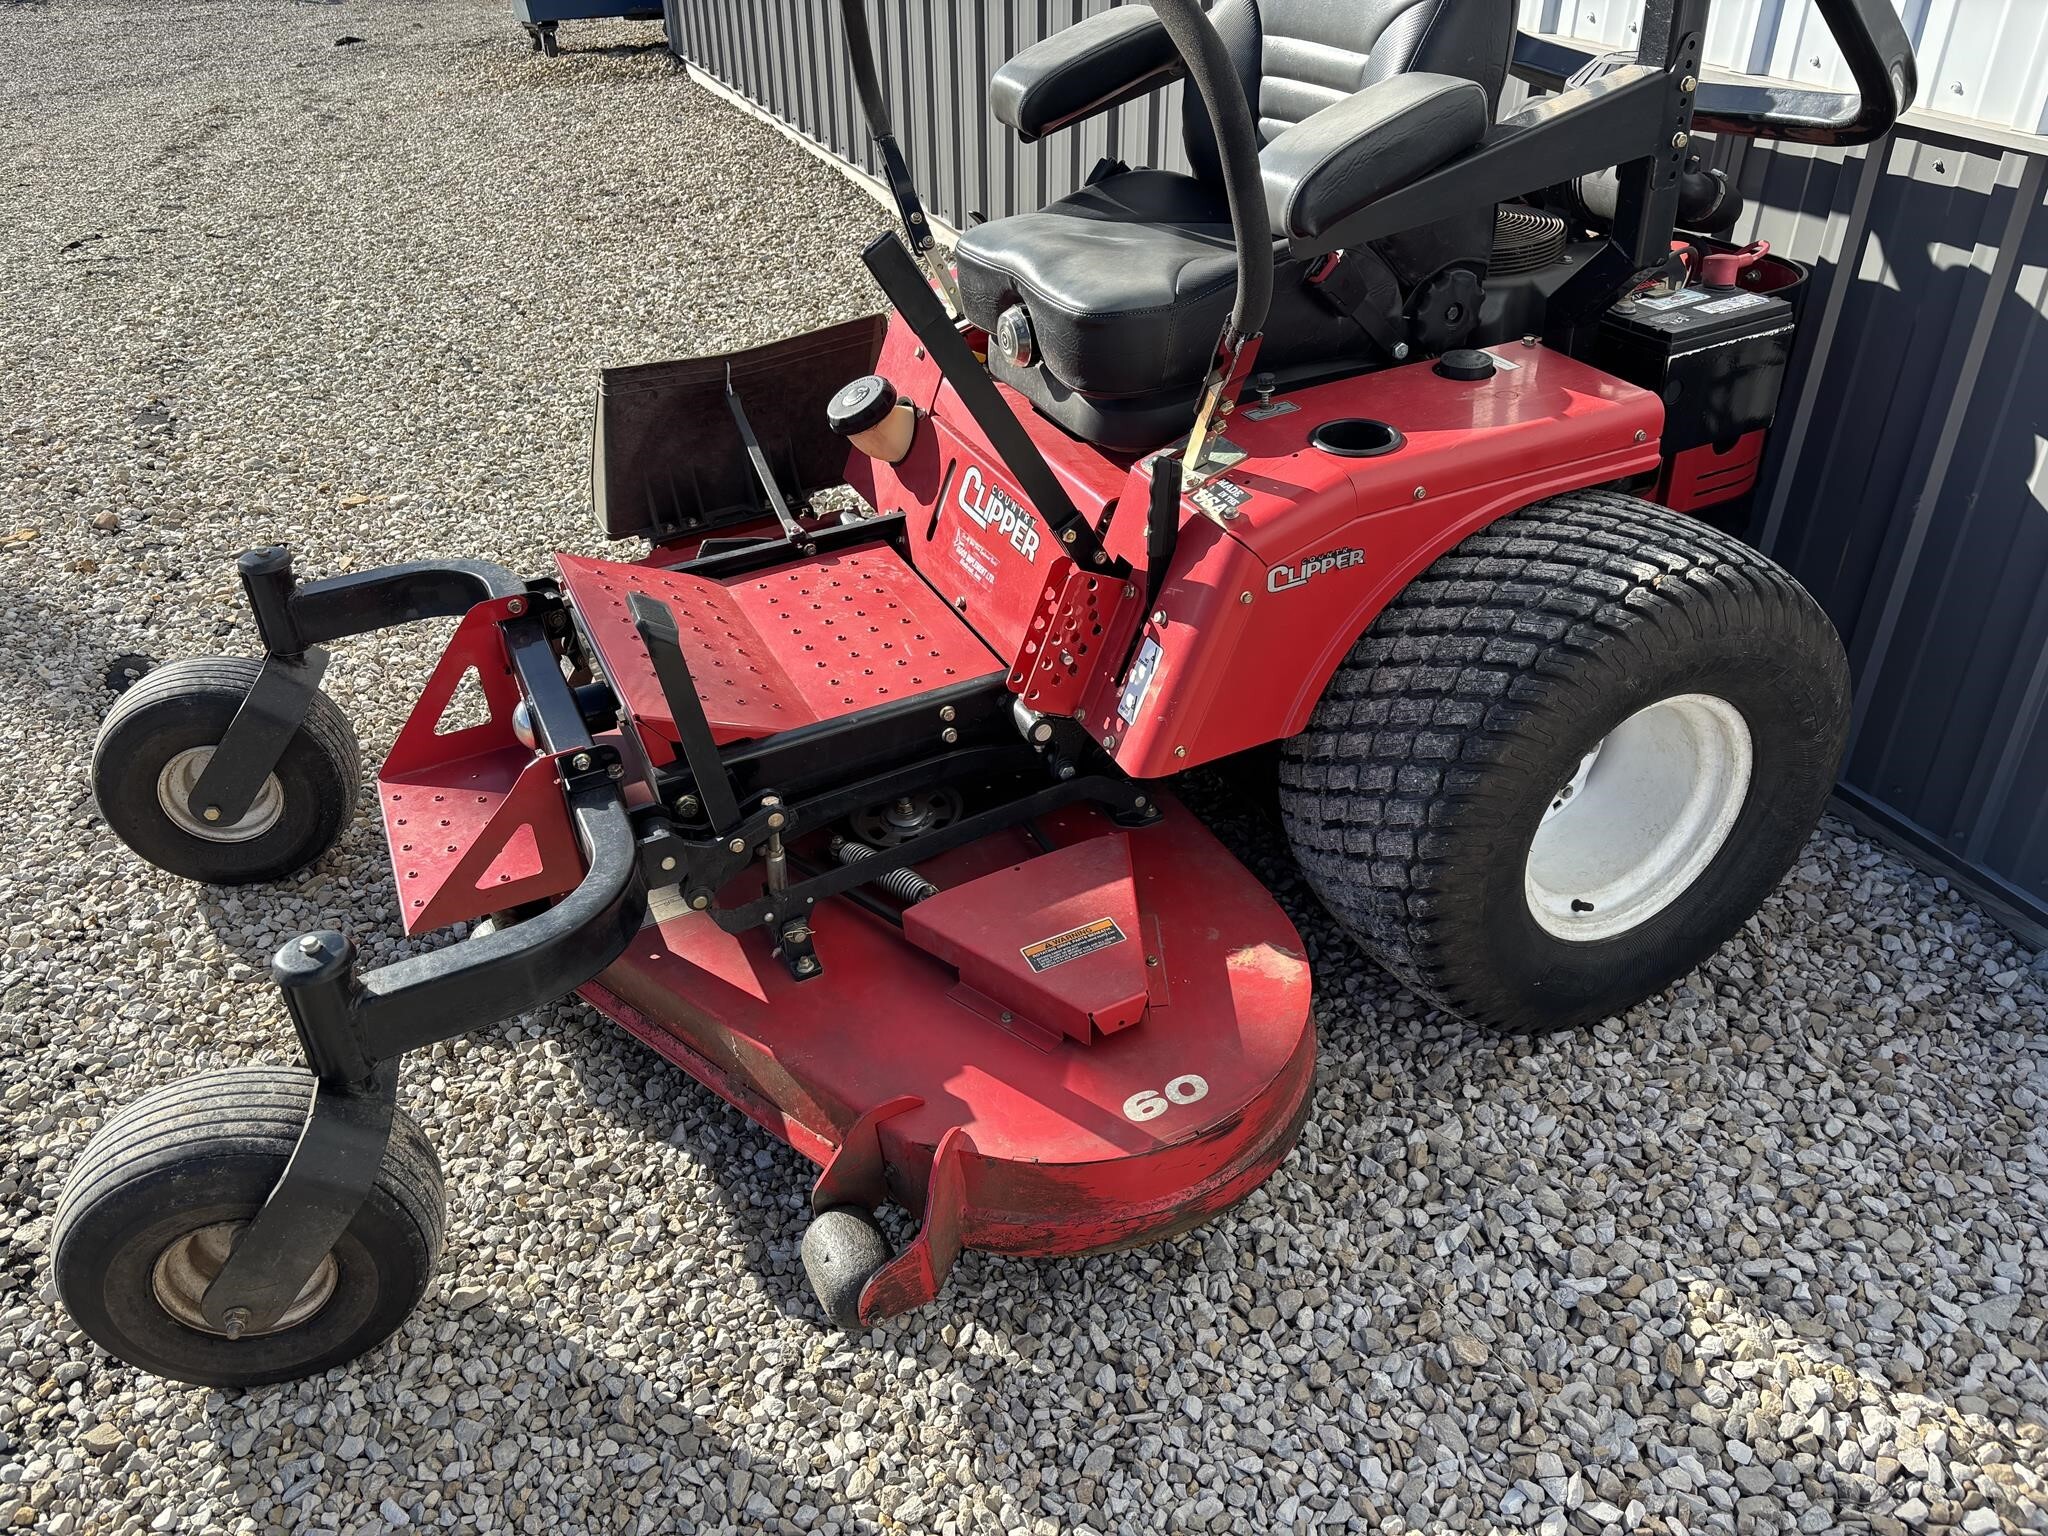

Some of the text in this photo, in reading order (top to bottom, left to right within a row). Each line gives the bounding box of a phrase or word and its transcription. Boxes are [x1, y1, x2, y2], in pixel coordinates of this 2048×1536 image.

[1193, 488, 1228, 513] USA
[1217, 479, 1244, 498] MADE
[1218, 490, 1240, 507] IN THE
[958, 465, 1040, 563] CLIPPER
[992, 484, 1039, 526] COUNTRY
[1302, 547, 1350, 564] COUNTR
[1267, 549, 1364, 593] CLIPPER
[1052, 927, 1093, 944] WARNING
[1122, 1074, 1209, 1122] 60
